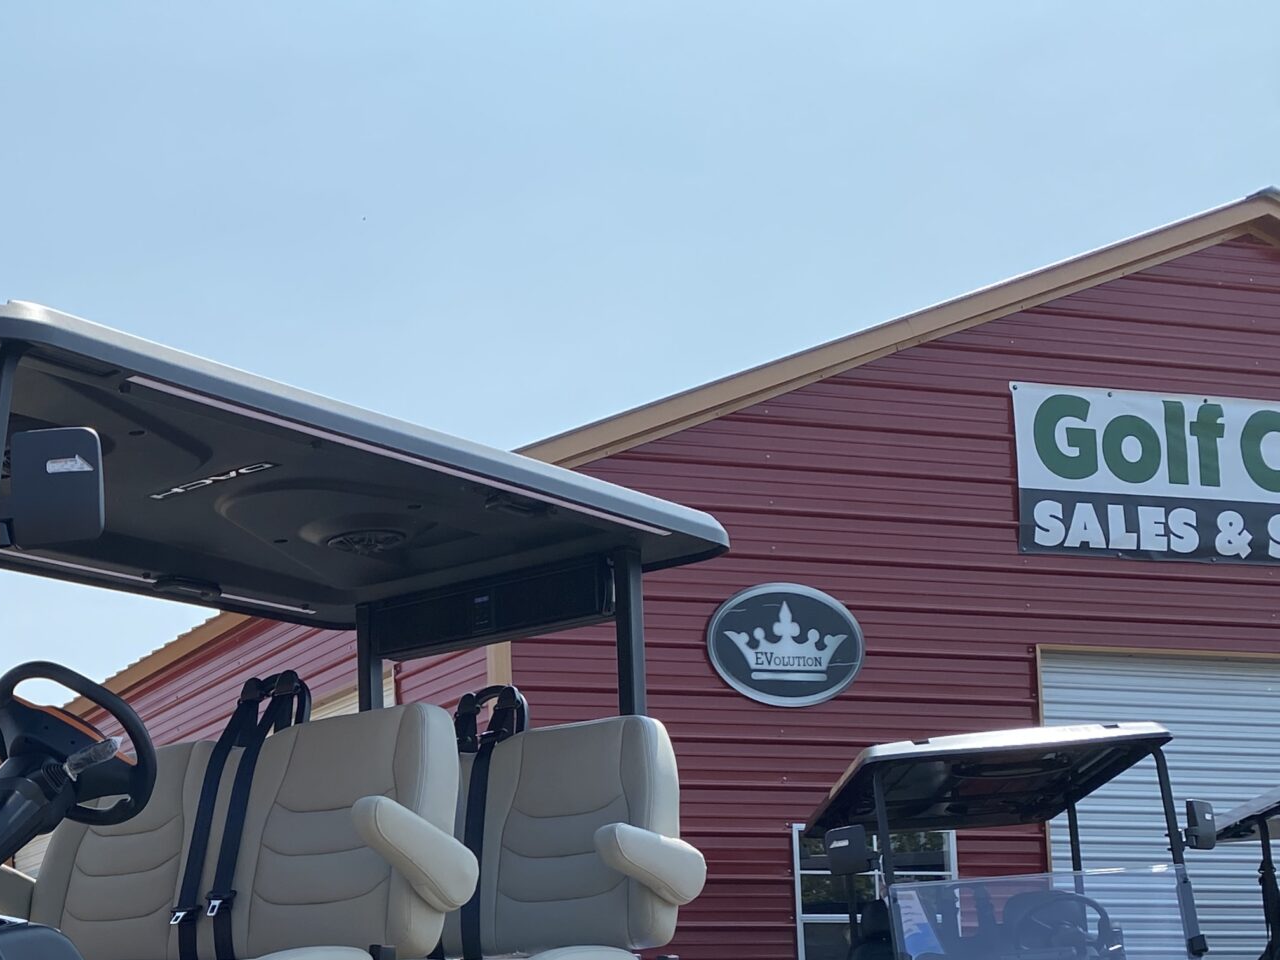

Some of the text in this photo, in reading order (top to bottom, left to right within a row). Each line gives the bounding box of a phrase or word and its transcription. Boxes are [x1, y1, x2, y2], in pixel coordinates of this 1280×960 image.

[1033, 394, 1225, 488] Golf
[1033, 500, 1200, 553] SALES
[1215, 510, 1253, 559] &
